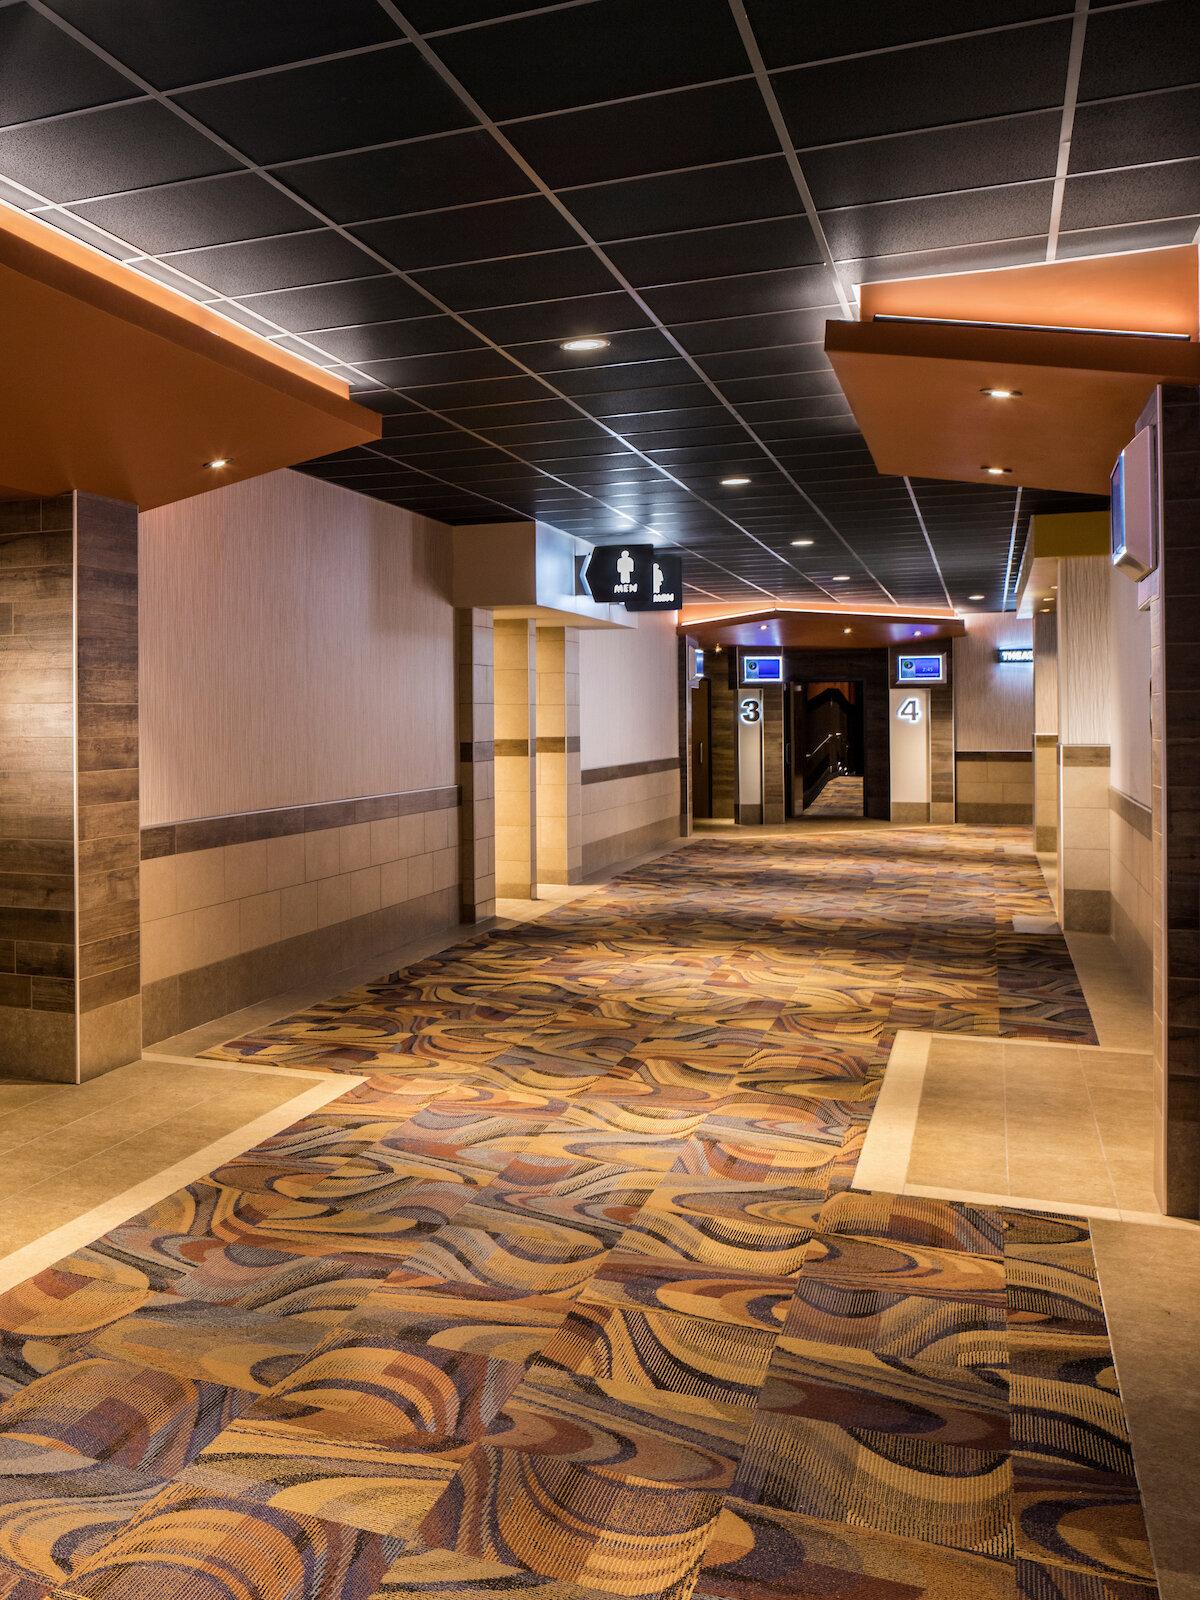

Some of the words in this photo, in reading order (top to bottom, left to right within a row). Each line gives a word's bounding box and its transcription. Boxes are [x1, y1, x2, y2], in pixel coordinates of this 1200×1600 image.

[614, 583, 638, 593] MEN
[741, 699, 760, 722] 3
[900, 699, 919, 721] 4
